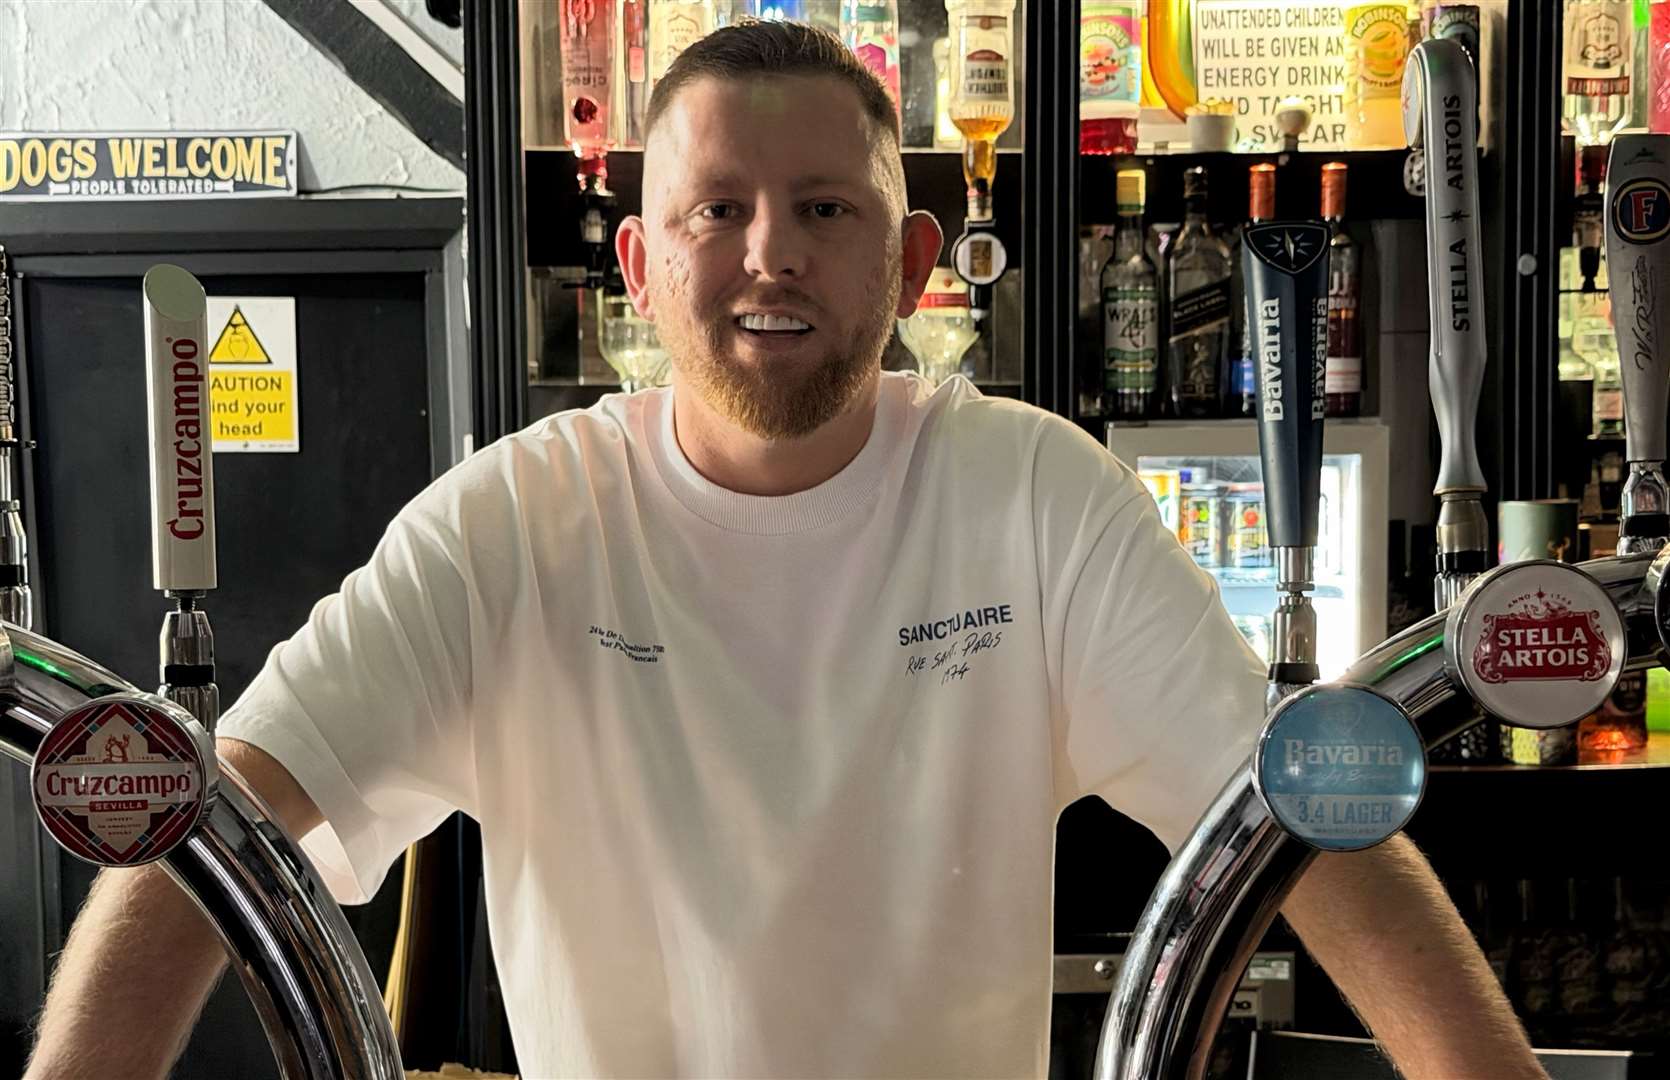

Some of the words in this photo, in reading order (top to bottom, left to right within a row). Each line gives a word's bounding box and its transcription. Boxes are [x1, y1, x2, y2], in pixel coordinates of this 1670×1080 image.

[1201, 9, 1281, 29] UNATTENDED
[1285, 8, 1344, 28] CHILDREN
[1202, 38, 1240, 59] WILL
[1246, 38, 1265, 58] BE
[1271, 37, 1319, 57] GIVEN
[1325, 36, 1344, 56] AN
[1204, 66, 1280, 88] ENERGY
[1288, 66, 1344, 86] DRINK
[1443, 95, 1463, 191] ARTOIS
[0, 138, 97, 192] DOGS
[108, 136, 287, 188] WELCOME
[71, 180, 126, 196] PEOPLE
[132, 178, 213, 194] TOLERATED
[1631, 191, 1658, 232] F
[1450, 238, 1470, 332] STELLA
[1262, 298, 1284, 422] Bavaria
[1312, 298, 1328, 420] Bavaria
[211, 376, 282, 391] AUTION
[211, 398, 239, 414] ind
[245, 402, 285, 418] your
[167, 338, 204, 540] Cruzcampo
[219, 421, 263, 436] head
[899, 605, 1013, 646] SANCTUAIRE
[1498, 627, 1588, 647] STELLA
[905, 656, 926, 677] RUE
[962, 632, 1002, 657] PARIS
[1498, 647, 1589, 667] ARTOIS
[1285, 739, 1403, 768] Bavaria
[46, 769, 189, 798] Cruzcampo
[95, 802, 143, 811] SEVILLA
[1298, 801, 1325, 824] 3.4
[1333, 801, 1393, 824] LAGER
